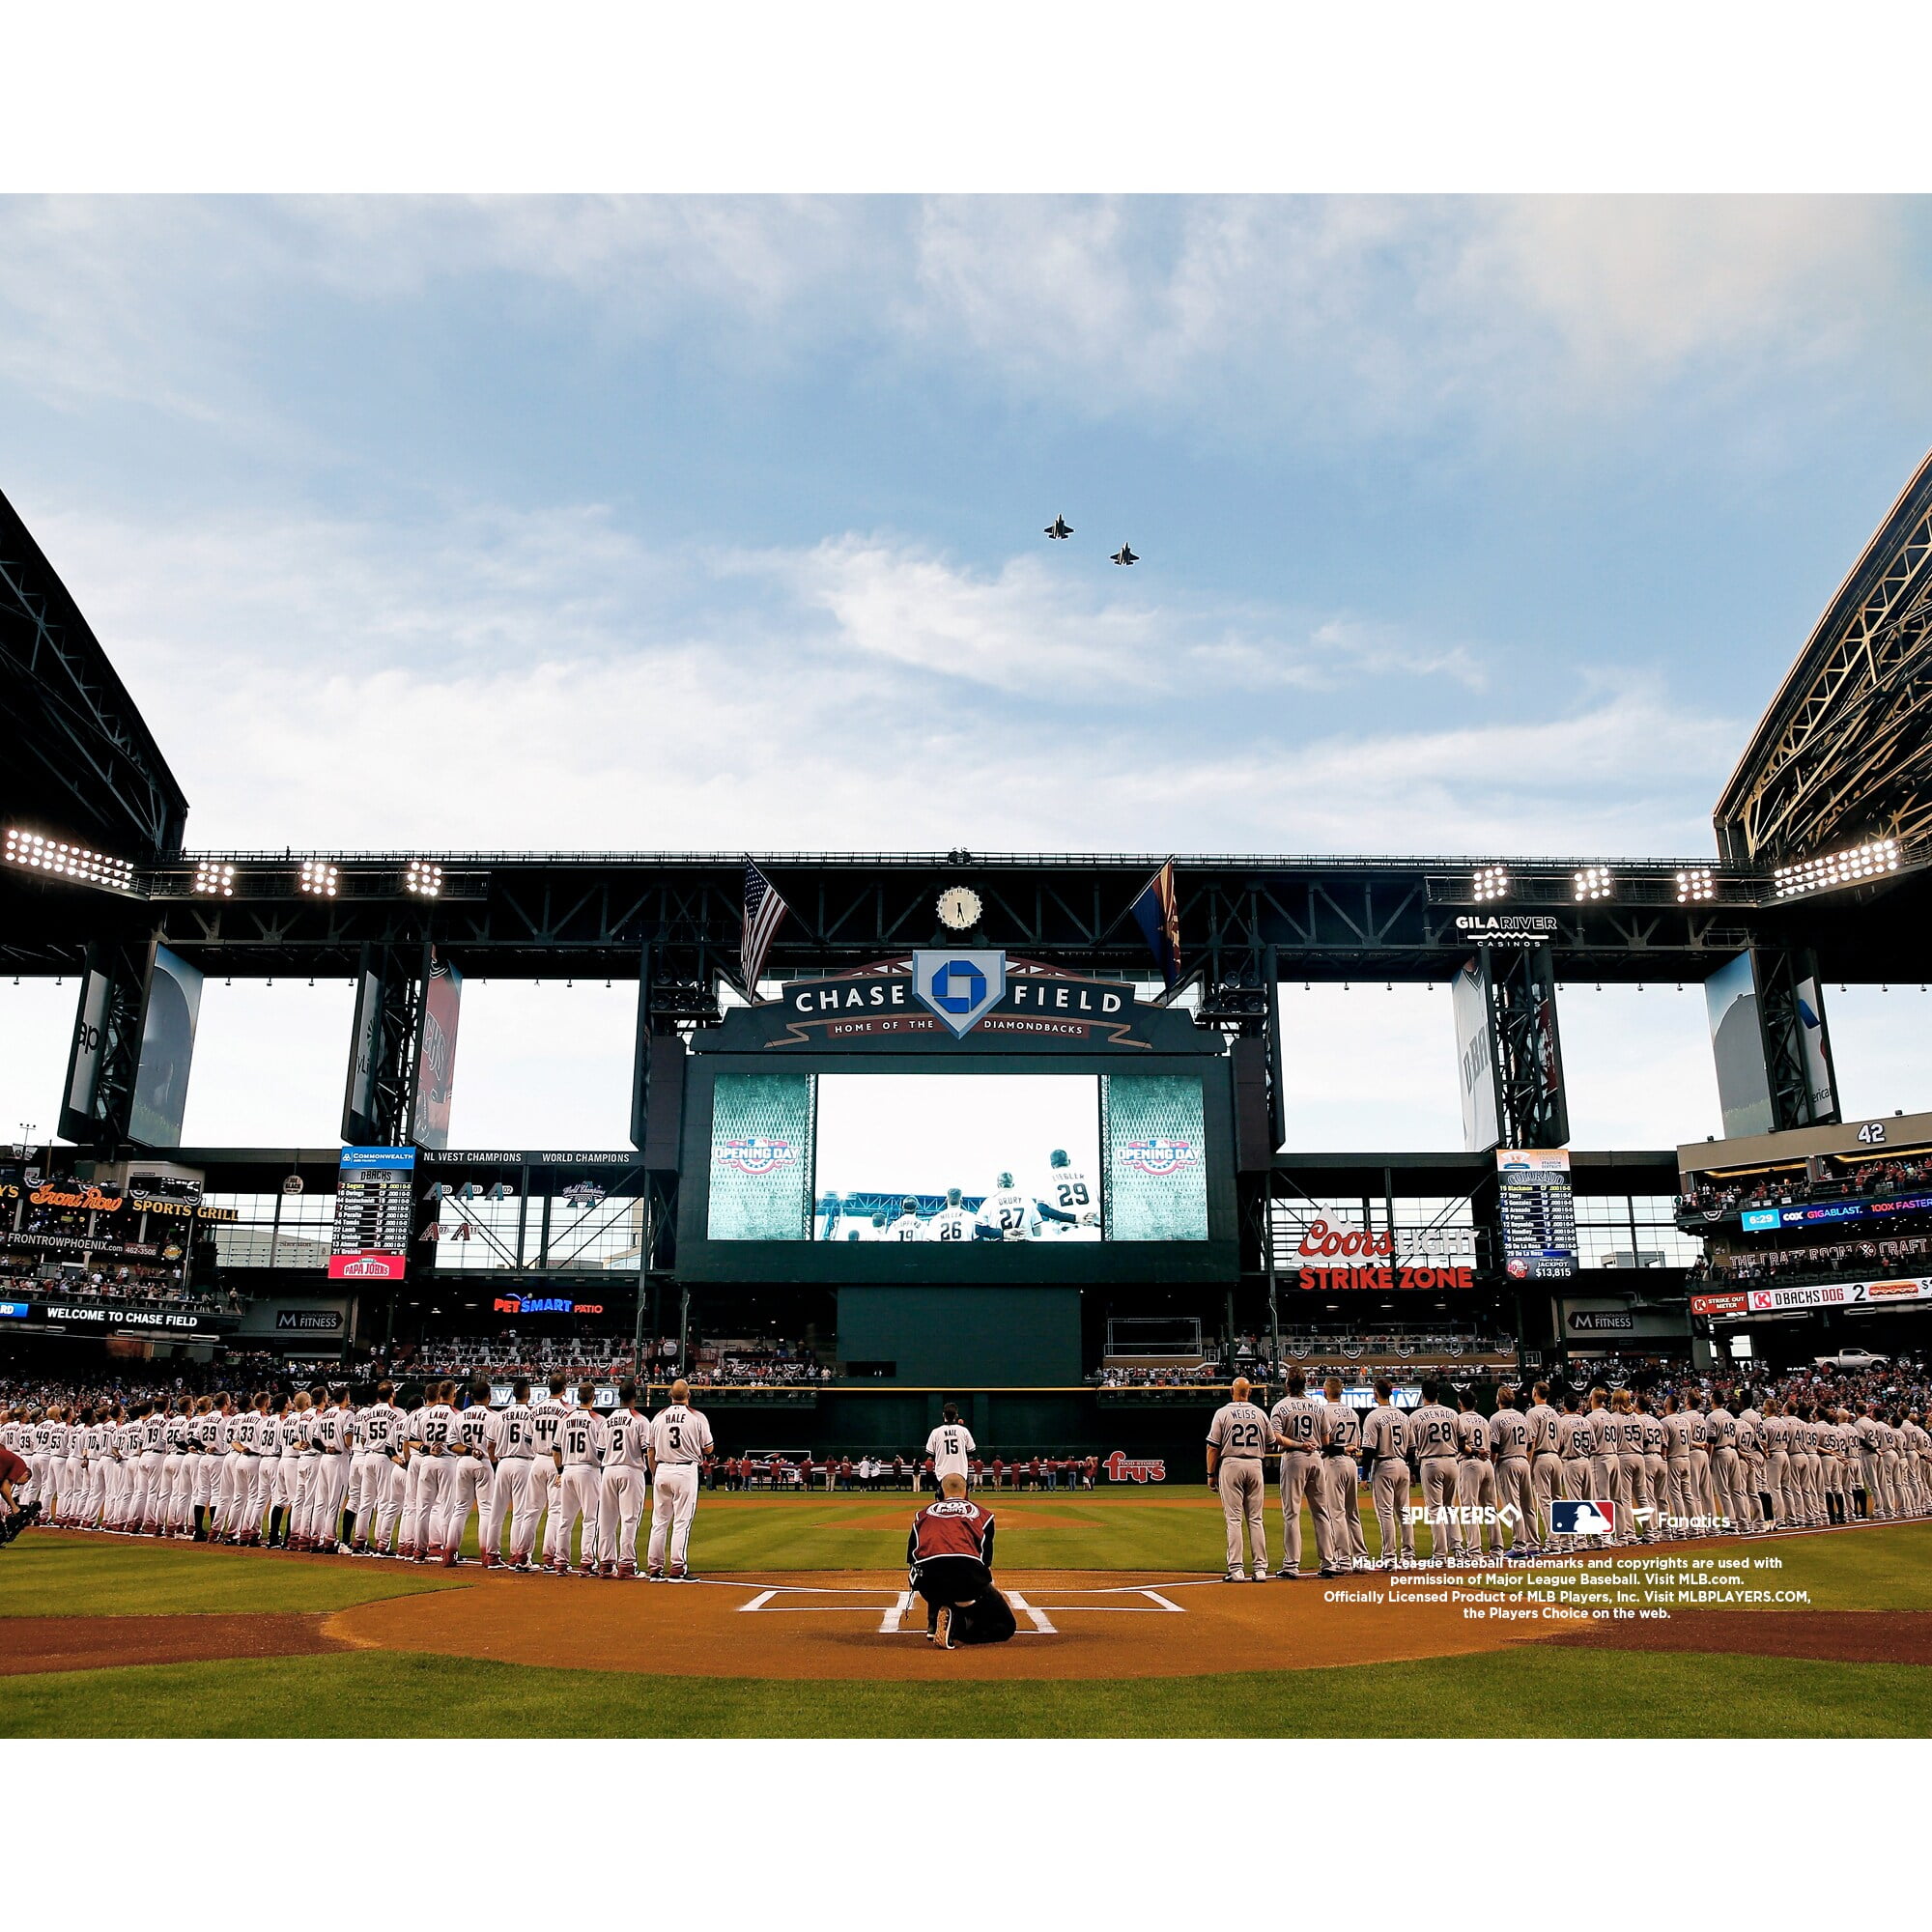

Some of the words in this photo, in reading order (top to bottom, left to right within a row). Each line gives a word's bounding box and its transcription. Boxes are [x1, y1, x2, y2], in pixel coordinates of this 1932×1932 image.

[795, 984, 905, 1012] CHASE
[1014, 985, 1122, 1013] FIELD
[834, 1023, 871, 1034] HOME
[983, 1021, 1083, 1035] DIAMONDBACKS
[1859, 1123, 1886, 1143] 42
[468, 1153, 522, 1162] CHAMPIONS
[542, 1153, 573, 1162] WORLD
[714, 1148, 772, 1159] OPENING
[774, 1148, 801, 1159] DAY
[1116, 1149, 1174, 1159] OPENING
[1176, 1149, 1201, 1159] DAY
[30, 1184, 83, 1207] Front
[82, 1188, 122, 1211] Row
[1057, 1183, 1089, 1206] 29
[133, 1200, 191, 1216] SPORTS
[197, 1207, 238, 1221] GRILL
[1000, 1208, 1024, 1229] 27
[1749, 1215, 1773, 1224] 6:29
[899, 1230, 913, 1241] 19
[941, 1221, 961, 1239] 26
[8, 1234, 123, 1252] FRONTROWPHOENIX.com
[1298, 1220, 1394, 1257] Coors
[1397, 1231, 1480, 1255] LIGHT
[346, 1264, 363, 1274] PAPA
[1536, 1268, 1571, 1277] $13,815
[1299, 1267, 1393, 1289] STRIKE
[1399, 1266, 1473, 1288] ZONE
[1822, 1289, 1844, 1301] DOG
[1853, 1285, 1865, 1301] 2
[494, 1298, 572, 1313] PETSMART
[47, 1307, 104, 1321] WELCOME
[108, 1312, 122, 1321] TO
[126, 1313, 163, 1324] CHASE
[166, 1316, 197, 1326] FIELD
[300, 1319, 336, 1327] FITNESS
[1595, 1319, 1631, 1327] FITNESS
[666, 1414, 686, 1424] HALE
[1231, 1409, 1256, 1419] WEISS
[1420, 1410, 1454, 1422] ARENADO
[321, 1422, 334, 1440] 46
[370, 1421, 386, 1439] 55
[535, 1420, 557, 1440] 44
[566, 1419, 590, 1429] OWINGS
[607, 1417, 633, 1429] SEGURA
[1293, 1415, 1312, 1437] 19
[1548, 1421, 1555, 1439] 9
[1723, 1424, 1735, 1437] 48
[36, 1432, 49, 1444] 49
[148, 1429, 158, 1442] 19
[203, 1427, 216, 1441] 29
[241, 1426, 254, 1441] 33
[262, 1430, 274, 1446] 38
[427, 1423, 447, 1441] 22
[463, 1424, 484, 1443] 24
[510, 1424, 520, 1443] 6
[613, 1429, 623, 1451] 2
[669, 1426, 680, 1449] 3
[1232, 1424, 1259, 1447] 22
[1336, 1421, 1355, 1443] 27
[1392, 1425, 1401, 1446] 5
[1429, 1422, 1451, 1442] 28
[1474, 1429, 1482, 1447] 8
[1513, 1426, 1525, 1445] 12
[1573, 1432, 1590, 1448] 65
[1605, 1426, 1616, 1442] 60
[1625, 1425, 1641, 1441] 55
[1648, 1428, 1660, 1444] 52
[1680, 1430, 1689, 1445] 51
[1696, 1426, 1706, 1441] 50
[1741, 1432, 1751, 1445] 47
[1776, 1431, 1787, 1444] 44
[1795, 1430, 1804, 1443] 41
[20, 1435, 30, 1448] 39
[51, 1435, 61, 1448] 53
[568, 1432, 585, 1453] 16
[944, 1439, 958, 1455] 15
[1102, 1451, 1166, 1483] fry's
